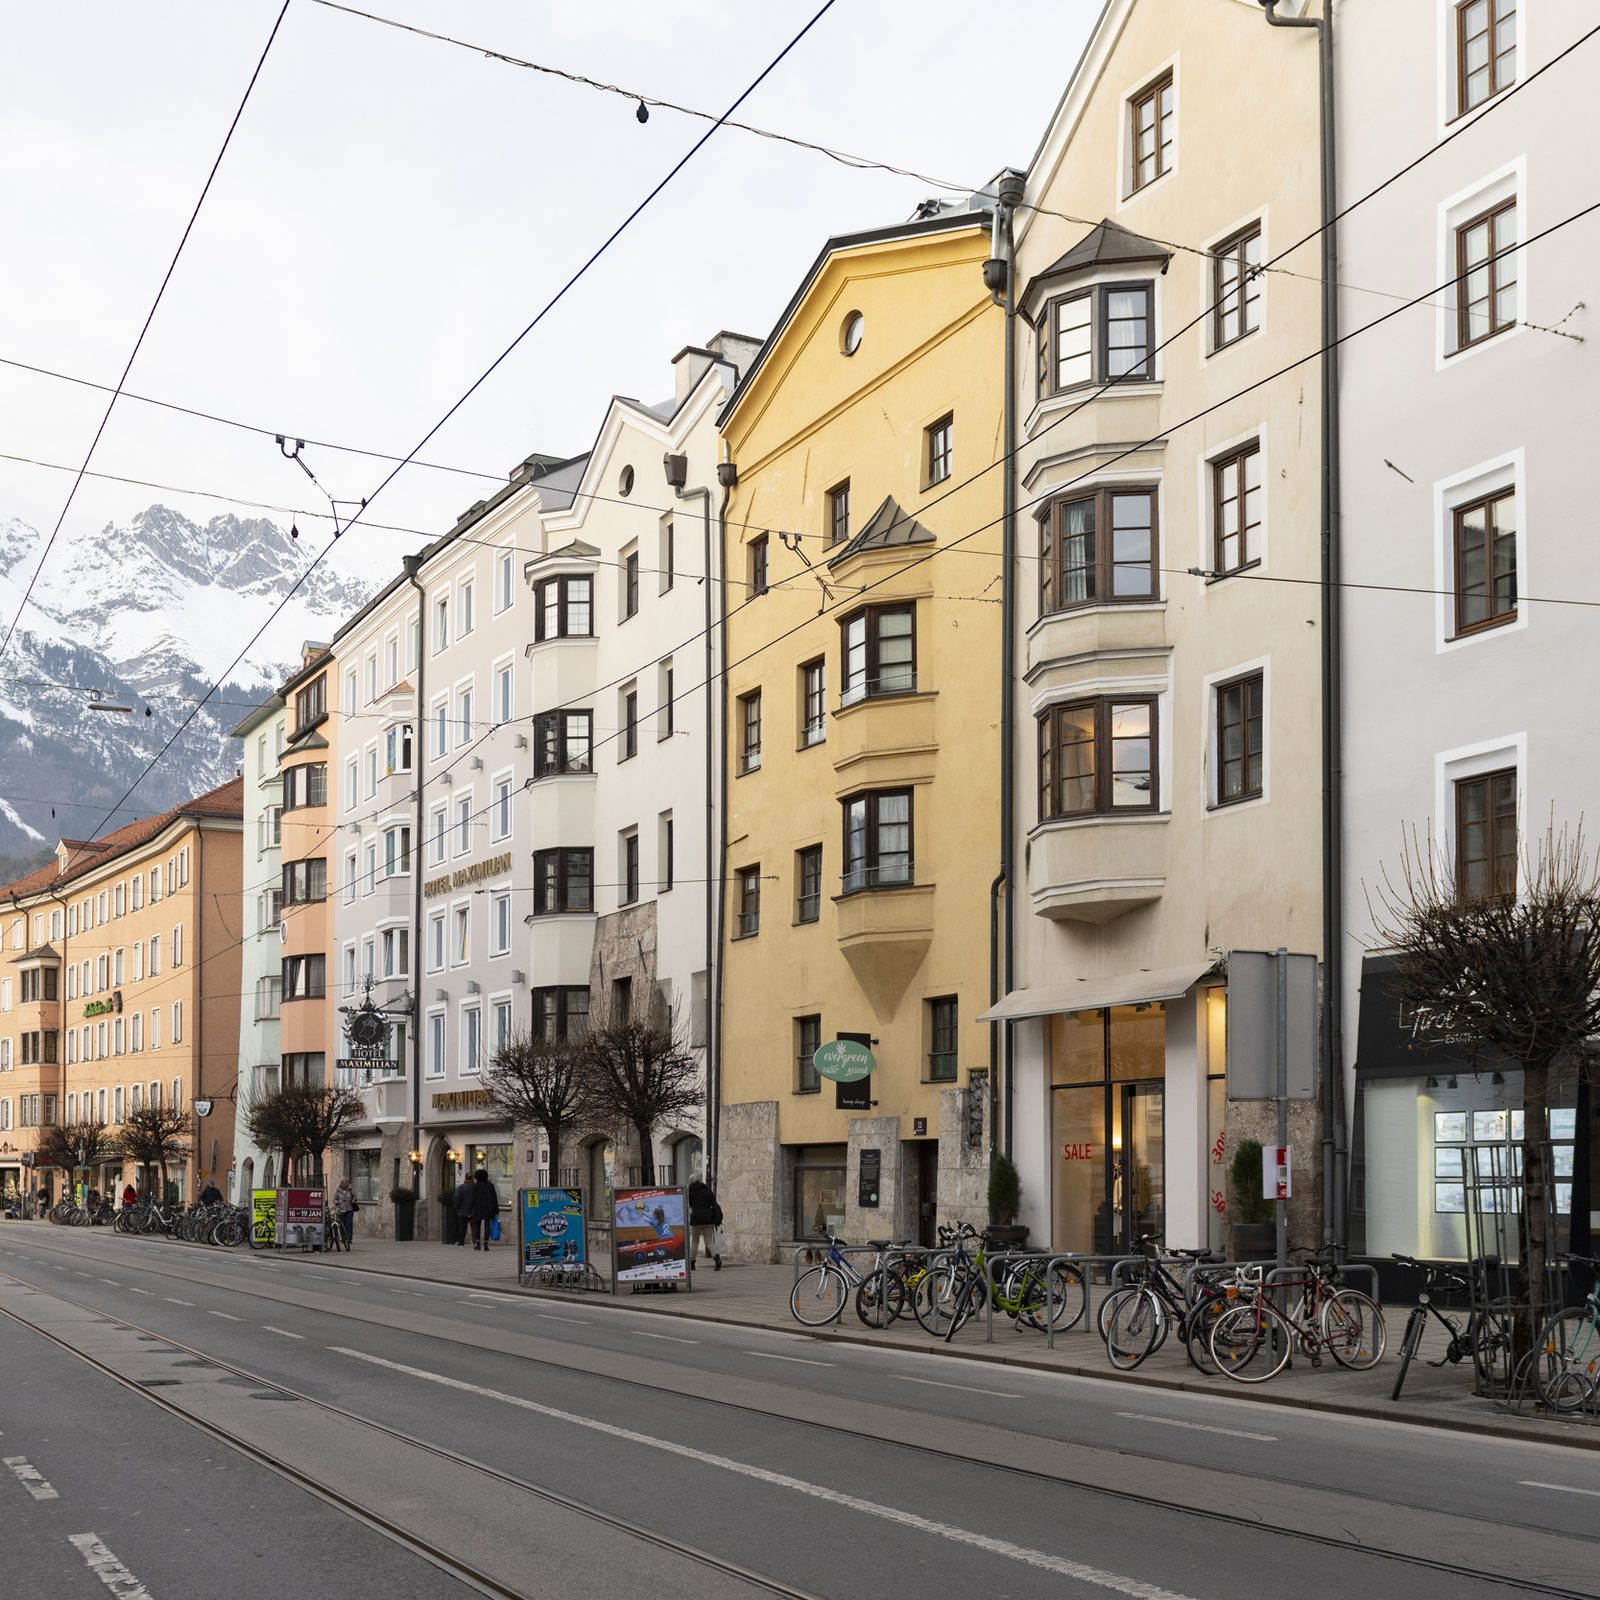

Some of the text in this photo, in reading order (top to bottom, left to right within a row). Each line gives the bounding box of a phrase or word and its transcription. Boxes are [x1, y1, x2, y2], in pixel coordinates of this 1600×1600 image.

[424, 852, 512, 899] HOTEL MAXIMILIAN
[354, 1050, 383, 1058] HOTEL
[823, 1051, 869, 1068] evergreen
[340, 1060, 397, 1068] MAXIMILIAN
[1064, 1143, 1092, 1160] SALE
[1212, 1189, 1226, 1220] -50
[663, 1223, 670, 1233] 2
